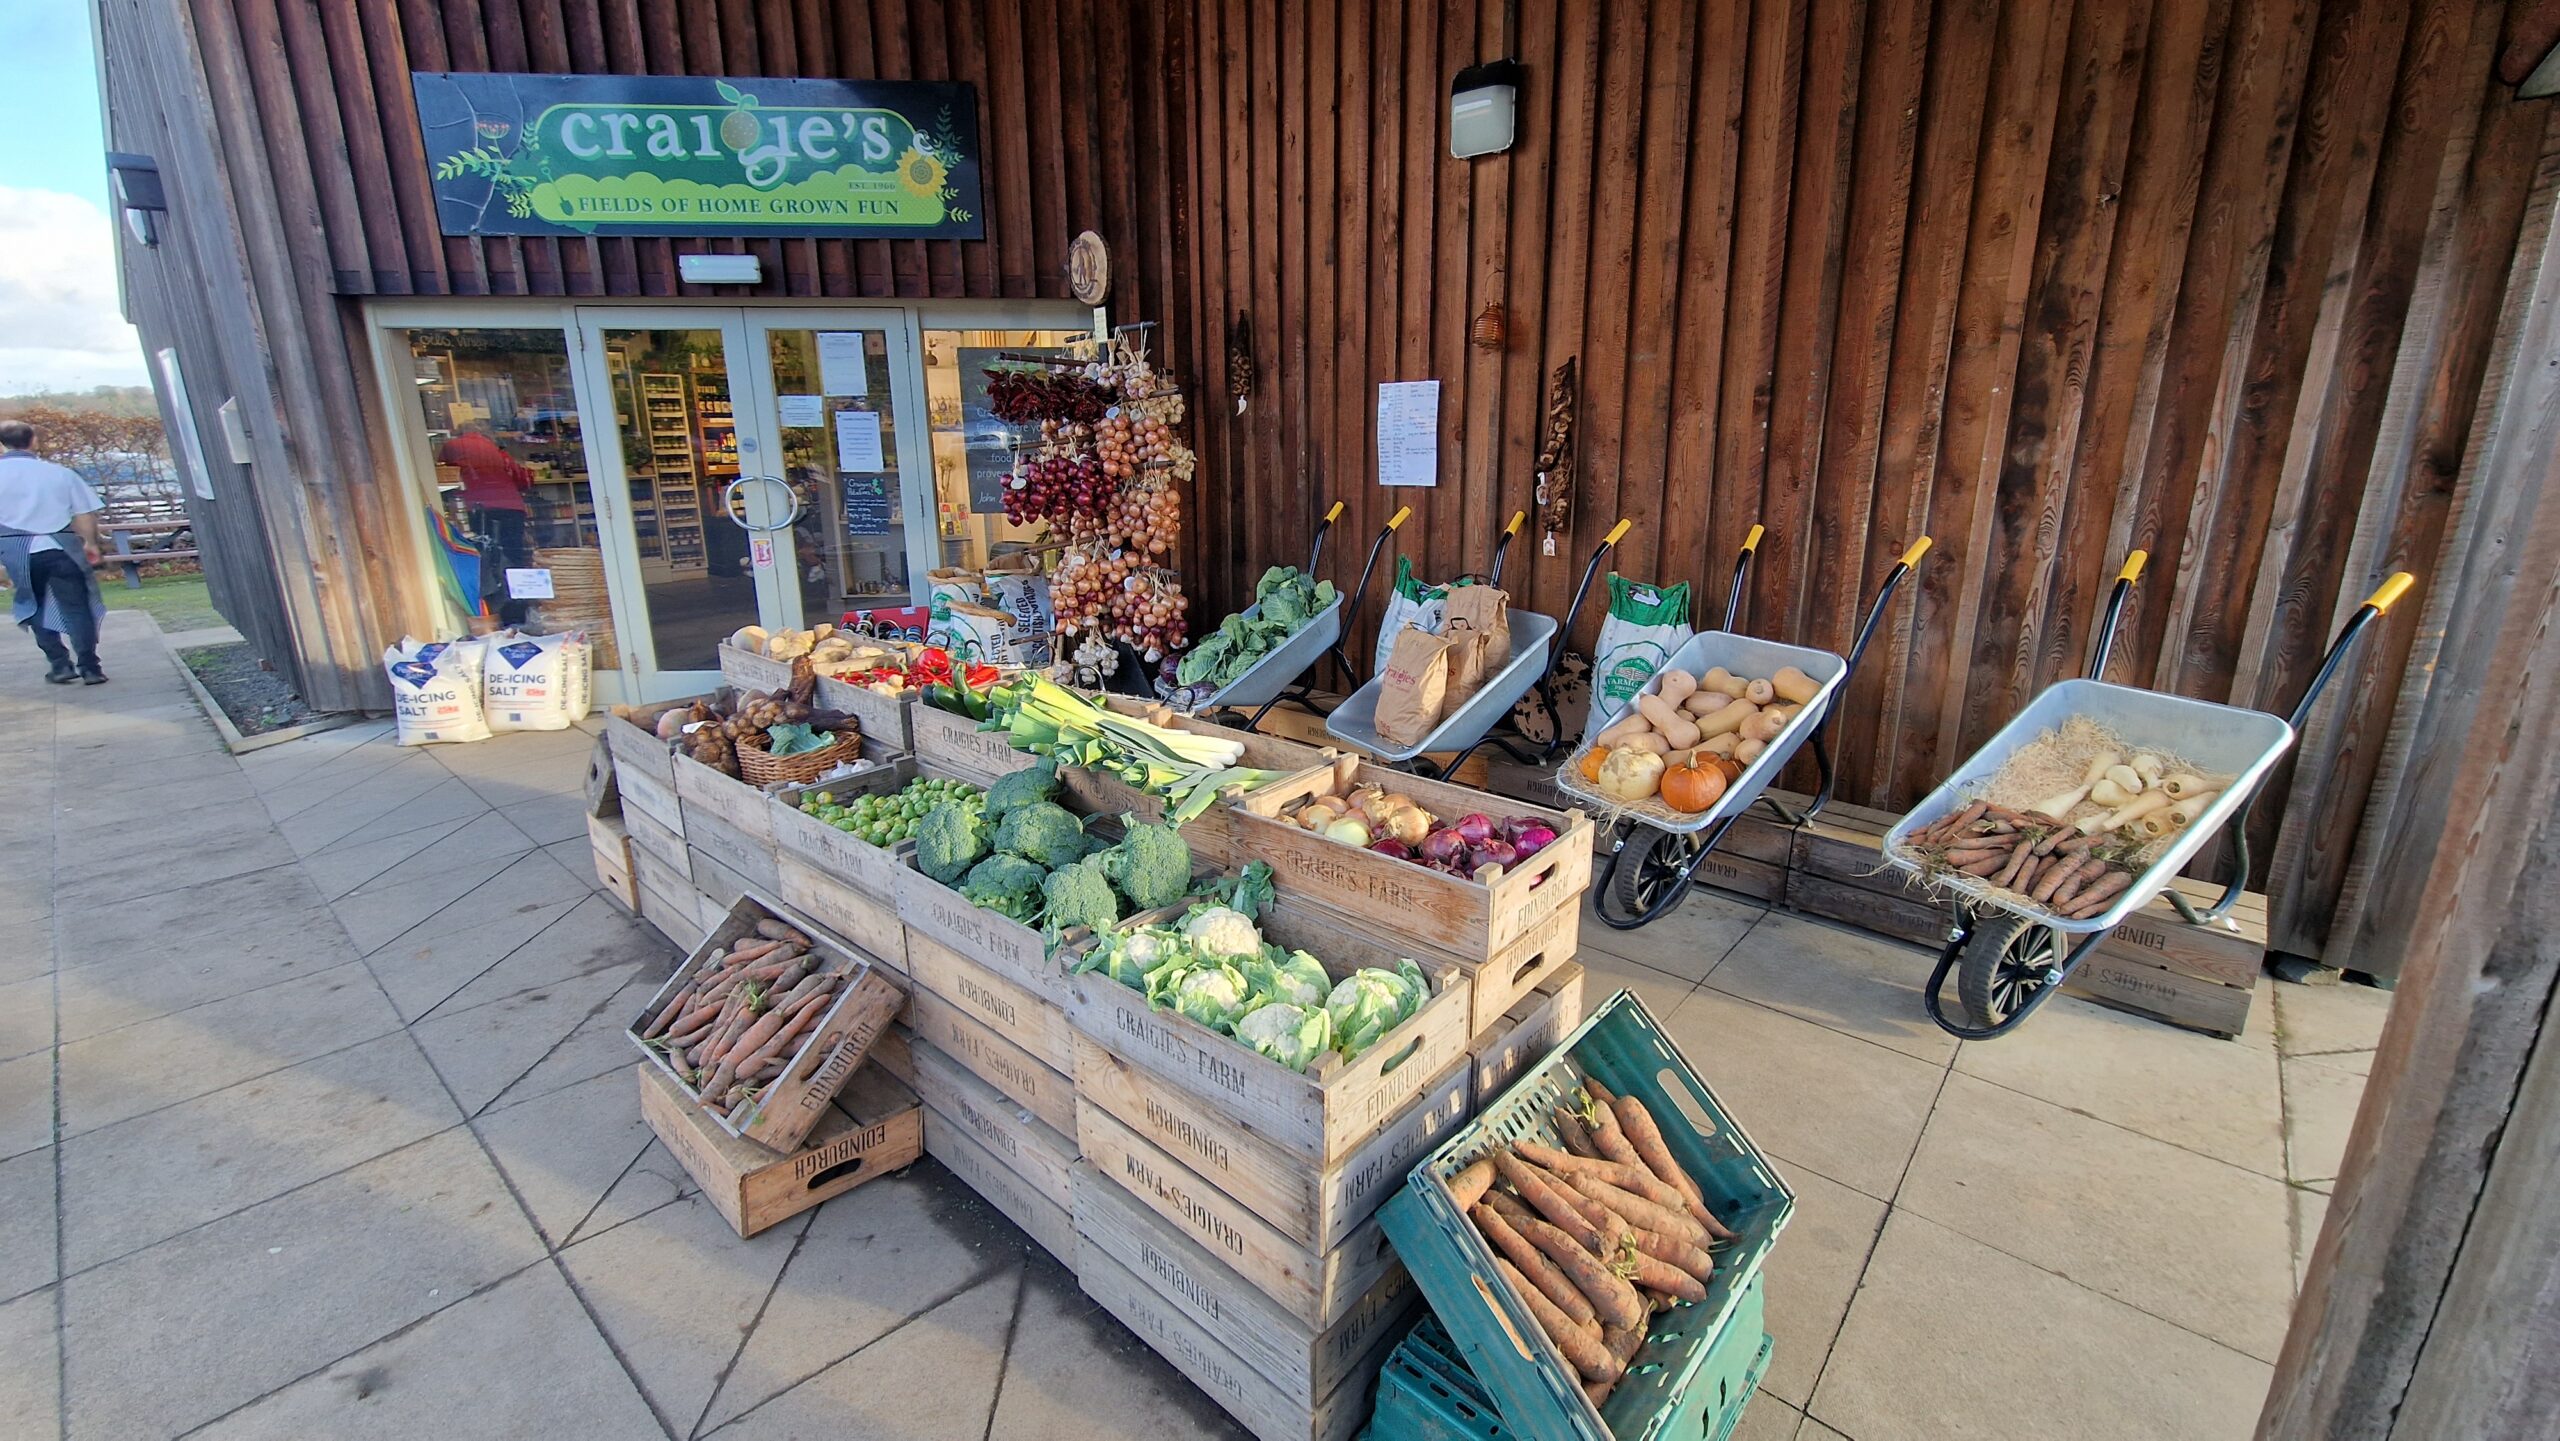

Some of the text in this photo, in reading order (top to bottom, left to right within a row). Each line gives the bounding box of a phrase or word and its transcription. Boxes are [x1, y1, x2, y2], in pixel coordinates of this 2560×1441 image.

[578, 197, 898, 215] FIELDS OF HOME GROWN FUN
[1031, 423, 1042, 435] yo
[991, 453, 1012, 463] food
[578, 648, 588, 666] SALT
[489, 673, 546, 684] DE-ICING
[489, 686, 518, 696] SALT
[560, 674, 568, 710] DE-ICING
[1607, 677, 1639, 688] FARMG
[396, 690, 456, 704] DE-ICING
[398, 706, 428, 717] SALT
[986, 740, 1013, 765] FARM
[838, 848, 863, 877] FARM
[1700, 860, 1738, 879] CRAIGI
[1369, 874, 1413, 912] FARM
[1517, 873, 1569, 933] EDINBURGH
[989, 932, 1020, 966] FARM
[1506, 914, 1560, 976] EDINBURGH
[2111, 925, 2166, 951] EDINB
[957, 974, 1016, 1026] EDINBURGH
[951, 1022, 979, 1058] FARM
[801, 1021, 876, 1111] EDINBURGH
[1198, 1048, 1246, 1099] FARM
[1367, 1043, 1437, 1124] EDINBURGH
[960, 1099, 1017, 1158] EDINBURGH
[1146, 1097, 1229, 1173] EDINBURGH
[794, 1124, 886, 1181] EDINBURGH
[952, 1143, 981, 1180] FARM
[1344, 1154, 1384, 1208] FARM
[1126, 1152, 1243, 1257] CRAIGIE'S FARM
[1140, 1242, 1220, 1321] EDINBURGH
[1128, 1292, 1164, 1339] FARM
[1339, 1298, 1377, 1357] FARM
